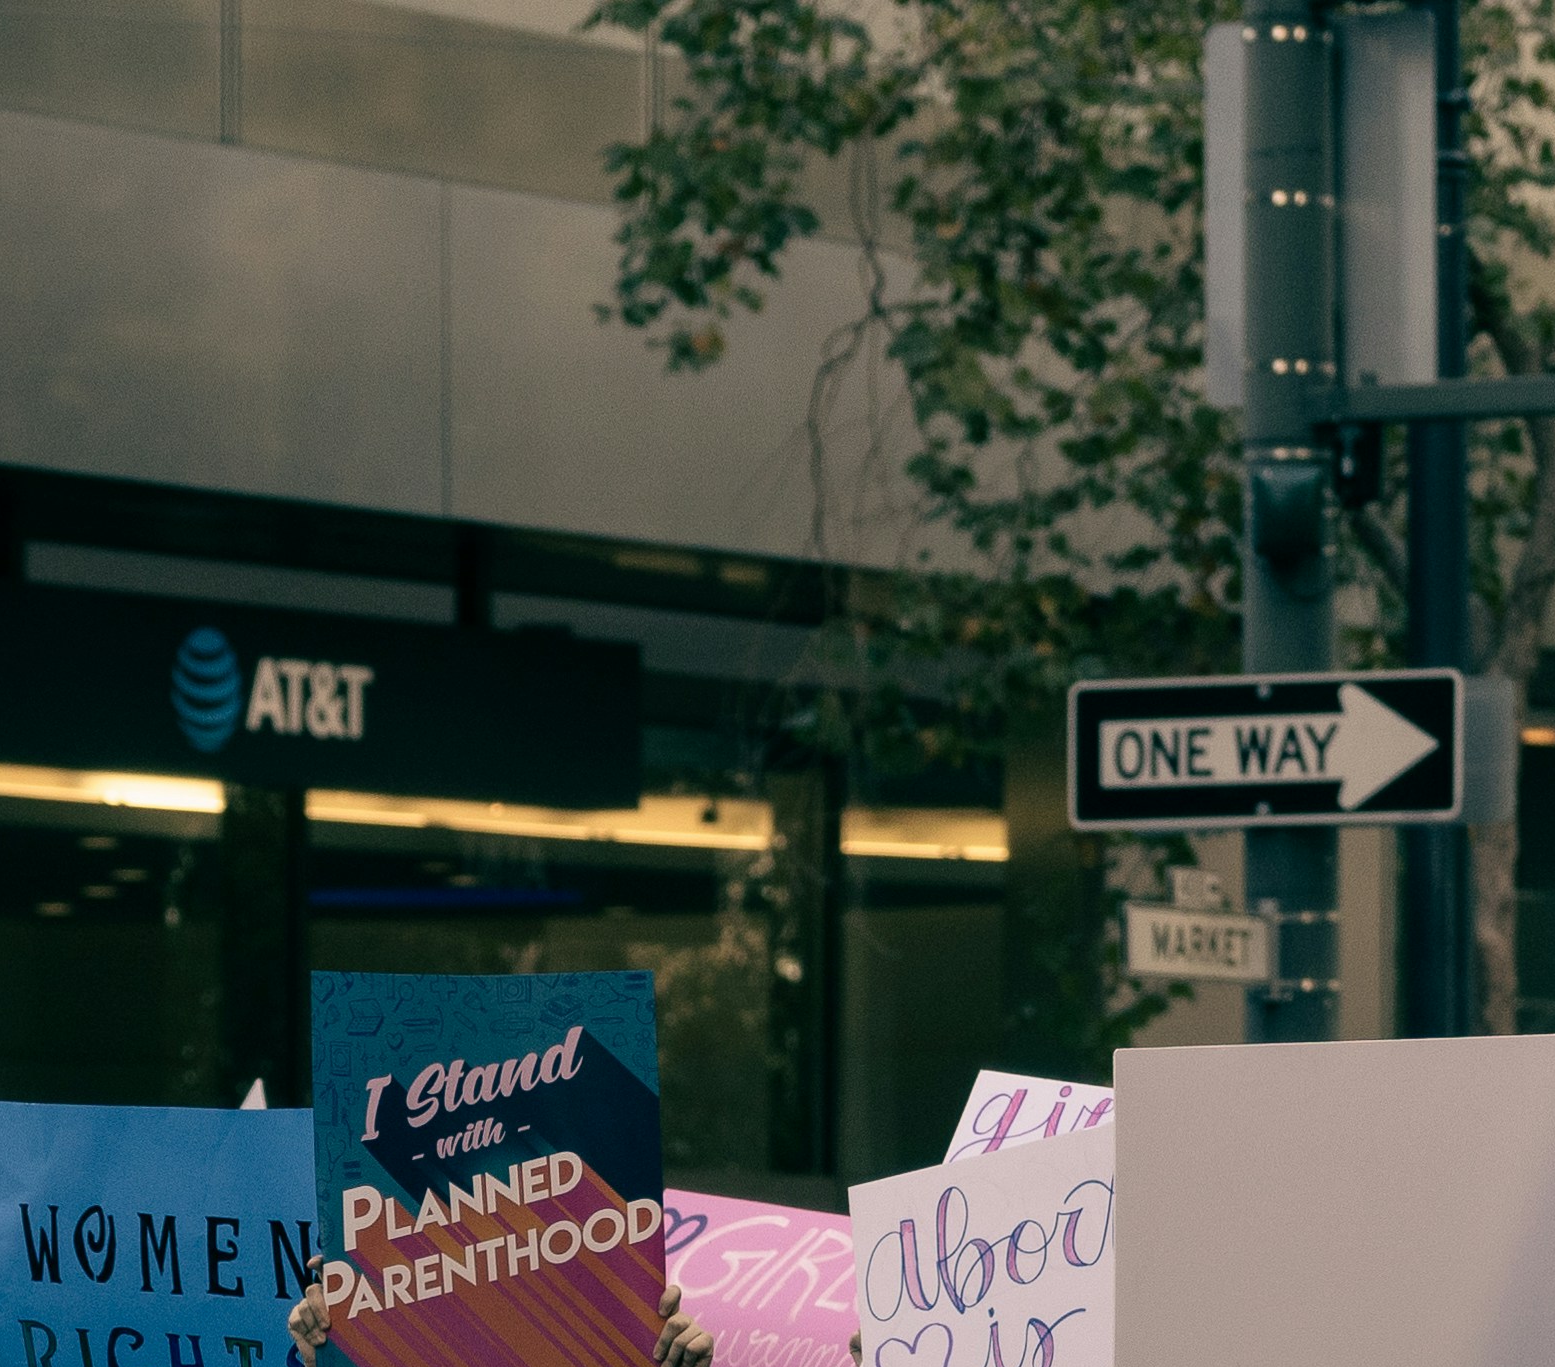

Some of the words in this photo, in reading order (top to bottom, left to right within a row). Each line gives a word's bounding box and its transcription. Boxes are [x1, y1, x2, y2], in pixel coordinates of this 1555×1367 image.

[245, 656, 375, 739] AT&T
[1114, 727, 1213, 780] ONE
[1235, 722, 1338, 777] WAY
[1151, 922, 1251, 967] MARKET
[361, 1073, 392, 1142] I
[405, 1026, 584, 1128] Stand
[436, 1117, 506, 1159] with
